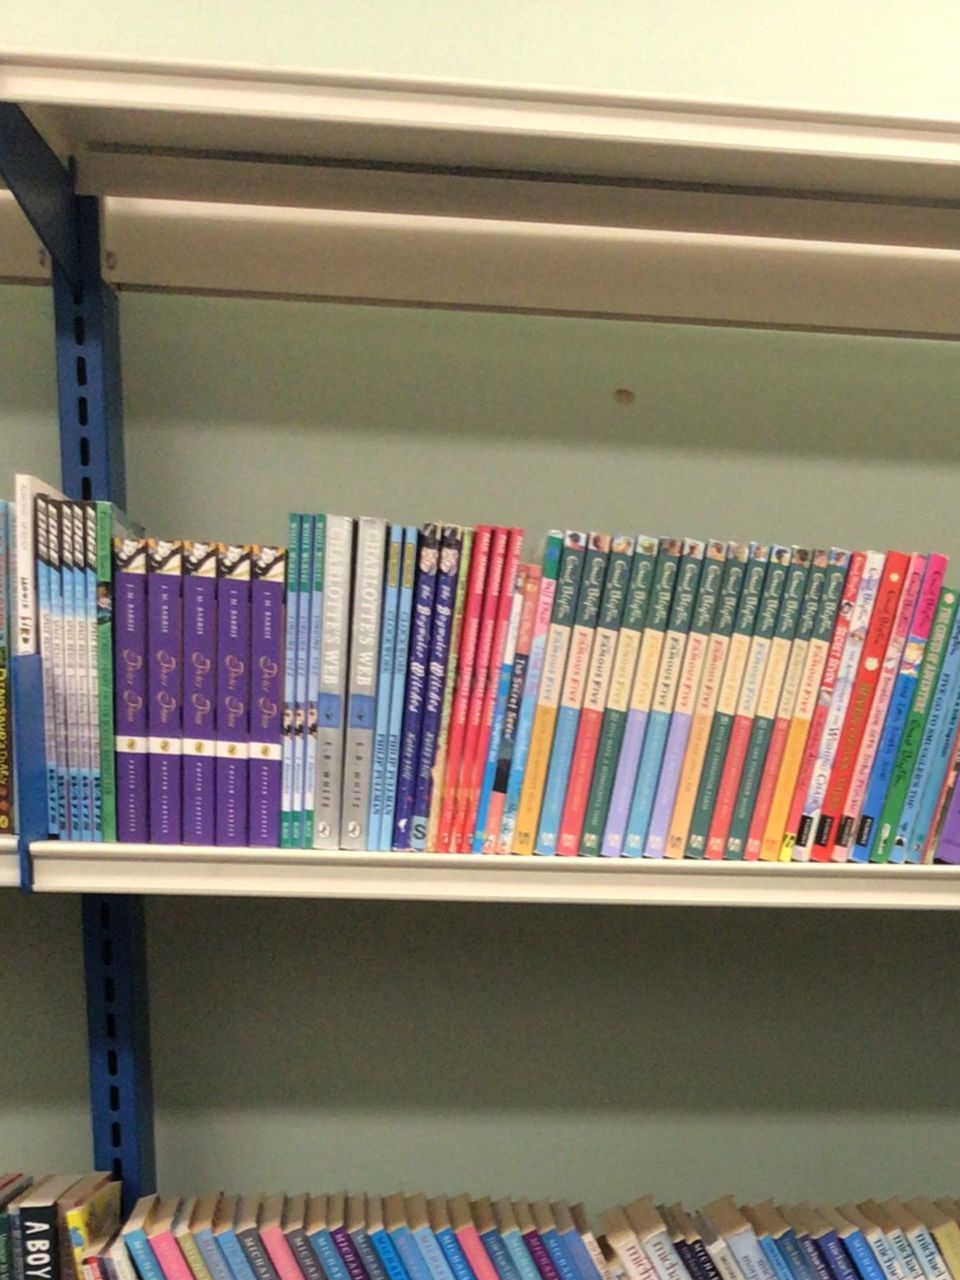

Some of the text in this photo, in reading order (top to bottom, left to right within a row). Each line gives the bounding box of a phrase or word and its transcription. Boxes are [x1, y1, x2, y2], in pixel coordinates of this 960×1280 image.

[324, 528, 344, 684] CHARLOTTE'S WEB
[357, 529, 380, 685] CHARLOTTE'S WEB
[590, 635, 611, 706] FAMOUS FIVE
[658, 637, 680, 708] FAMOUS FIVE
[373, 770, 382, 815] PULLMAN
[384, 770, 394, 815] PULLMAN
[25, 1222, 50, 1236] A
[26, 1240, 51, 1280] BOY
[335, 1232, 364, 1280] MICHAEL
[892, 1236, 923, 1280] michael
[915, 1234, 943, 1278] michael
